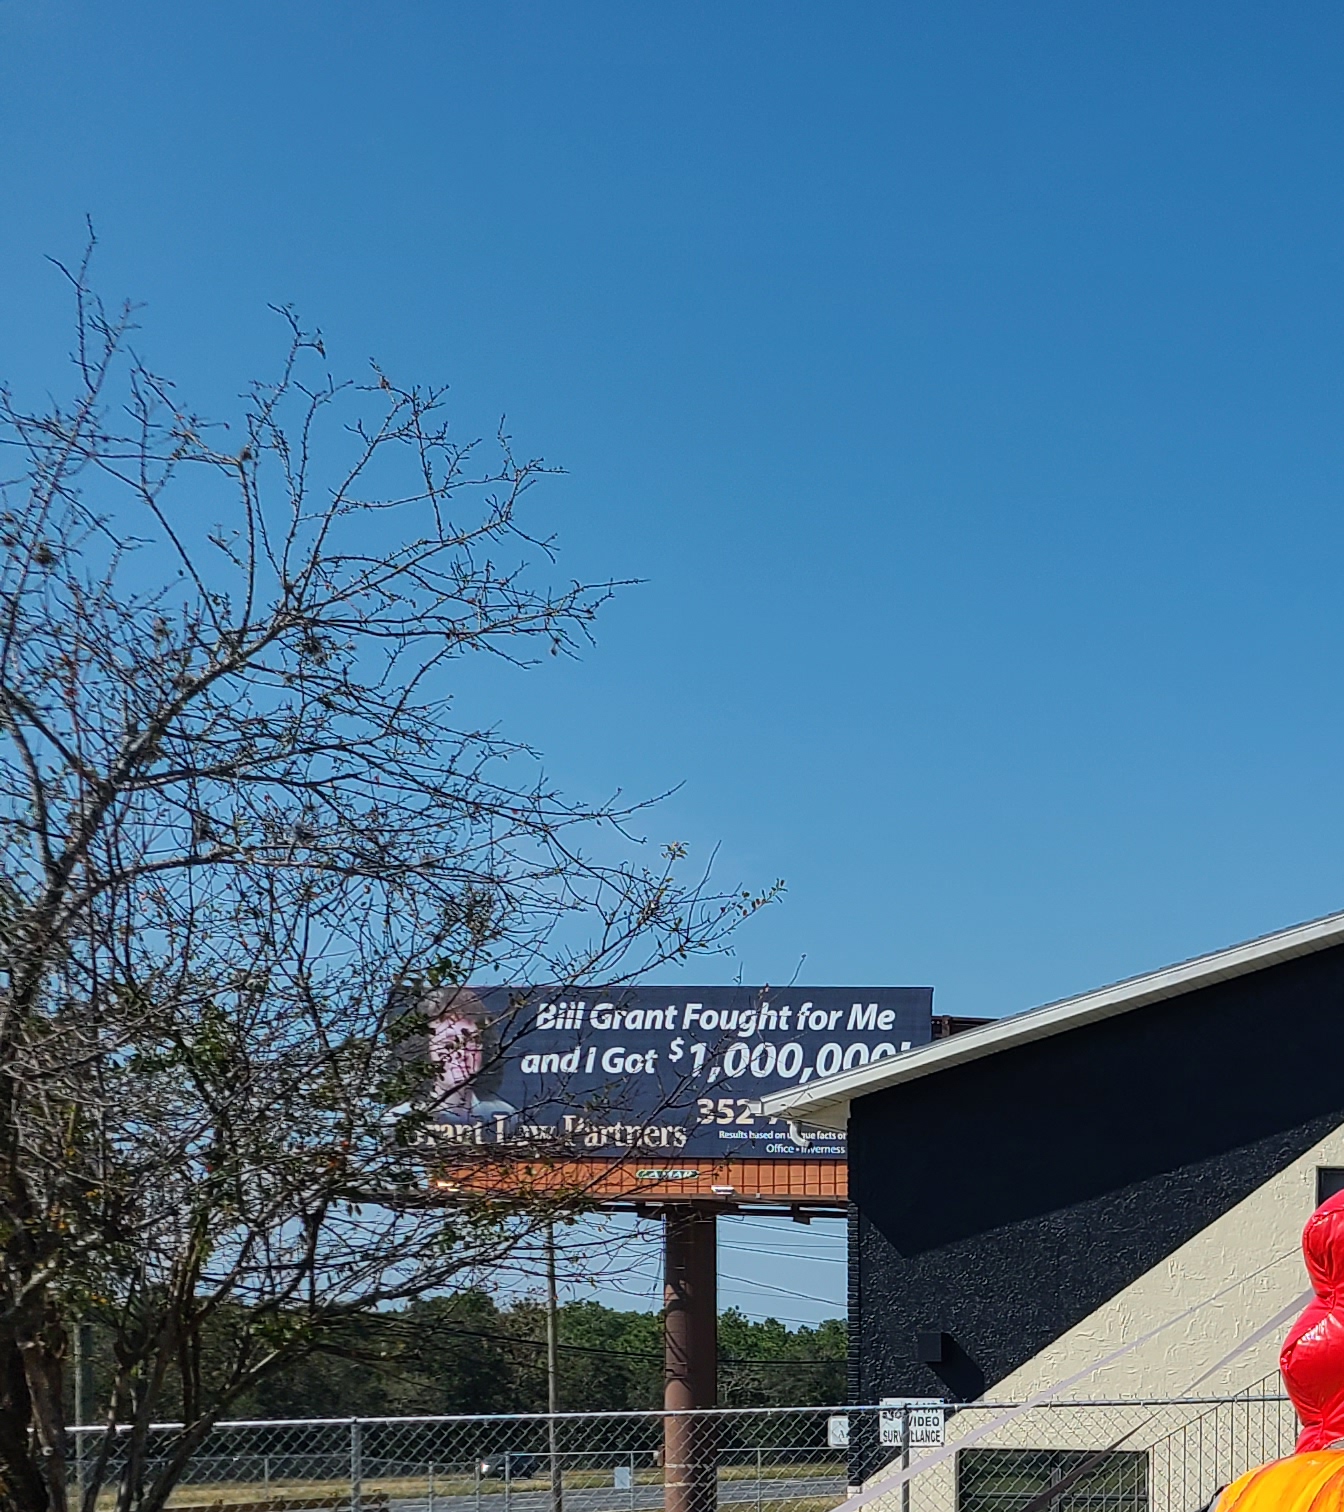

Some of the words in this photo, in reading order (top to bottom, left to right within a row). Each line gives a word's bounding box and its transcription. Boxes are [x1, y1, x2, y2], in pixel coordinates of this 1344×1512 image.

[535, 1002, 586, 1030] Bill
[589, 1002, 678, 1030] Grant
[682, 1002, 792, 1037] Fought
[797, 1002, 842, 1030] for
[847, 1003, 896, 1030] Me
[520, 1045, 582, 1074] and
[585, 1047, 597, 1074] I
[601, 1047, 659, 1074] Got
[668, 1037, 911, 1083] $1,000,00
[562, 1114, 687, 1148] Partners
[718, 1130, 748, 1140] Results
[749, 1130, 774, 1140] based
[775, 1132, 786, 1140] on
[787, 1132, 816, 1141] uque
[817, 1130, 837, 1140] facts
[766, 1143, 795, 1153] Office
[801, 1144, 846, 1154] Inverness
[883, 1430, 941, 1443] SURVLLANCE
